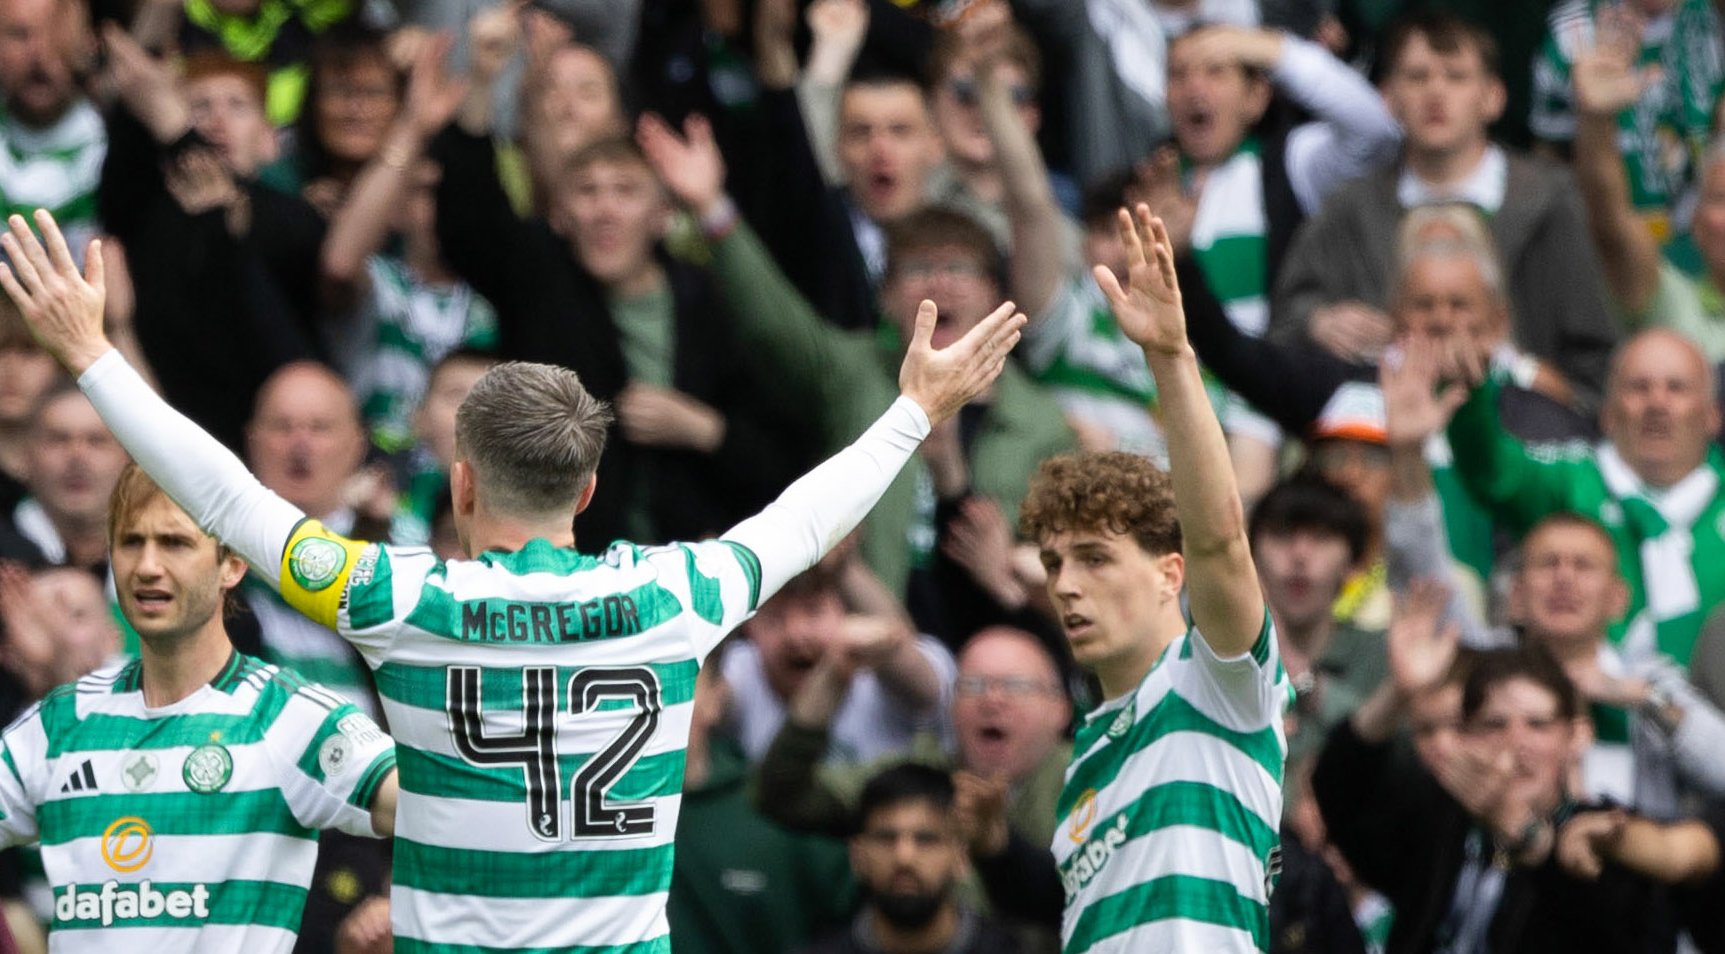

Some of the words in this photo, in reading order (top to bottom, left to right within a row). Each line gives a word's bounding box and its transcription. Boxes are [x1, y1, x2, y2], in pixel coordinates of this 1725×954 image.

[461, 596, 642, 642] McGREGOR
[446, 665, 662, 842] 42
[56, 880, 210, 926] dafabet
